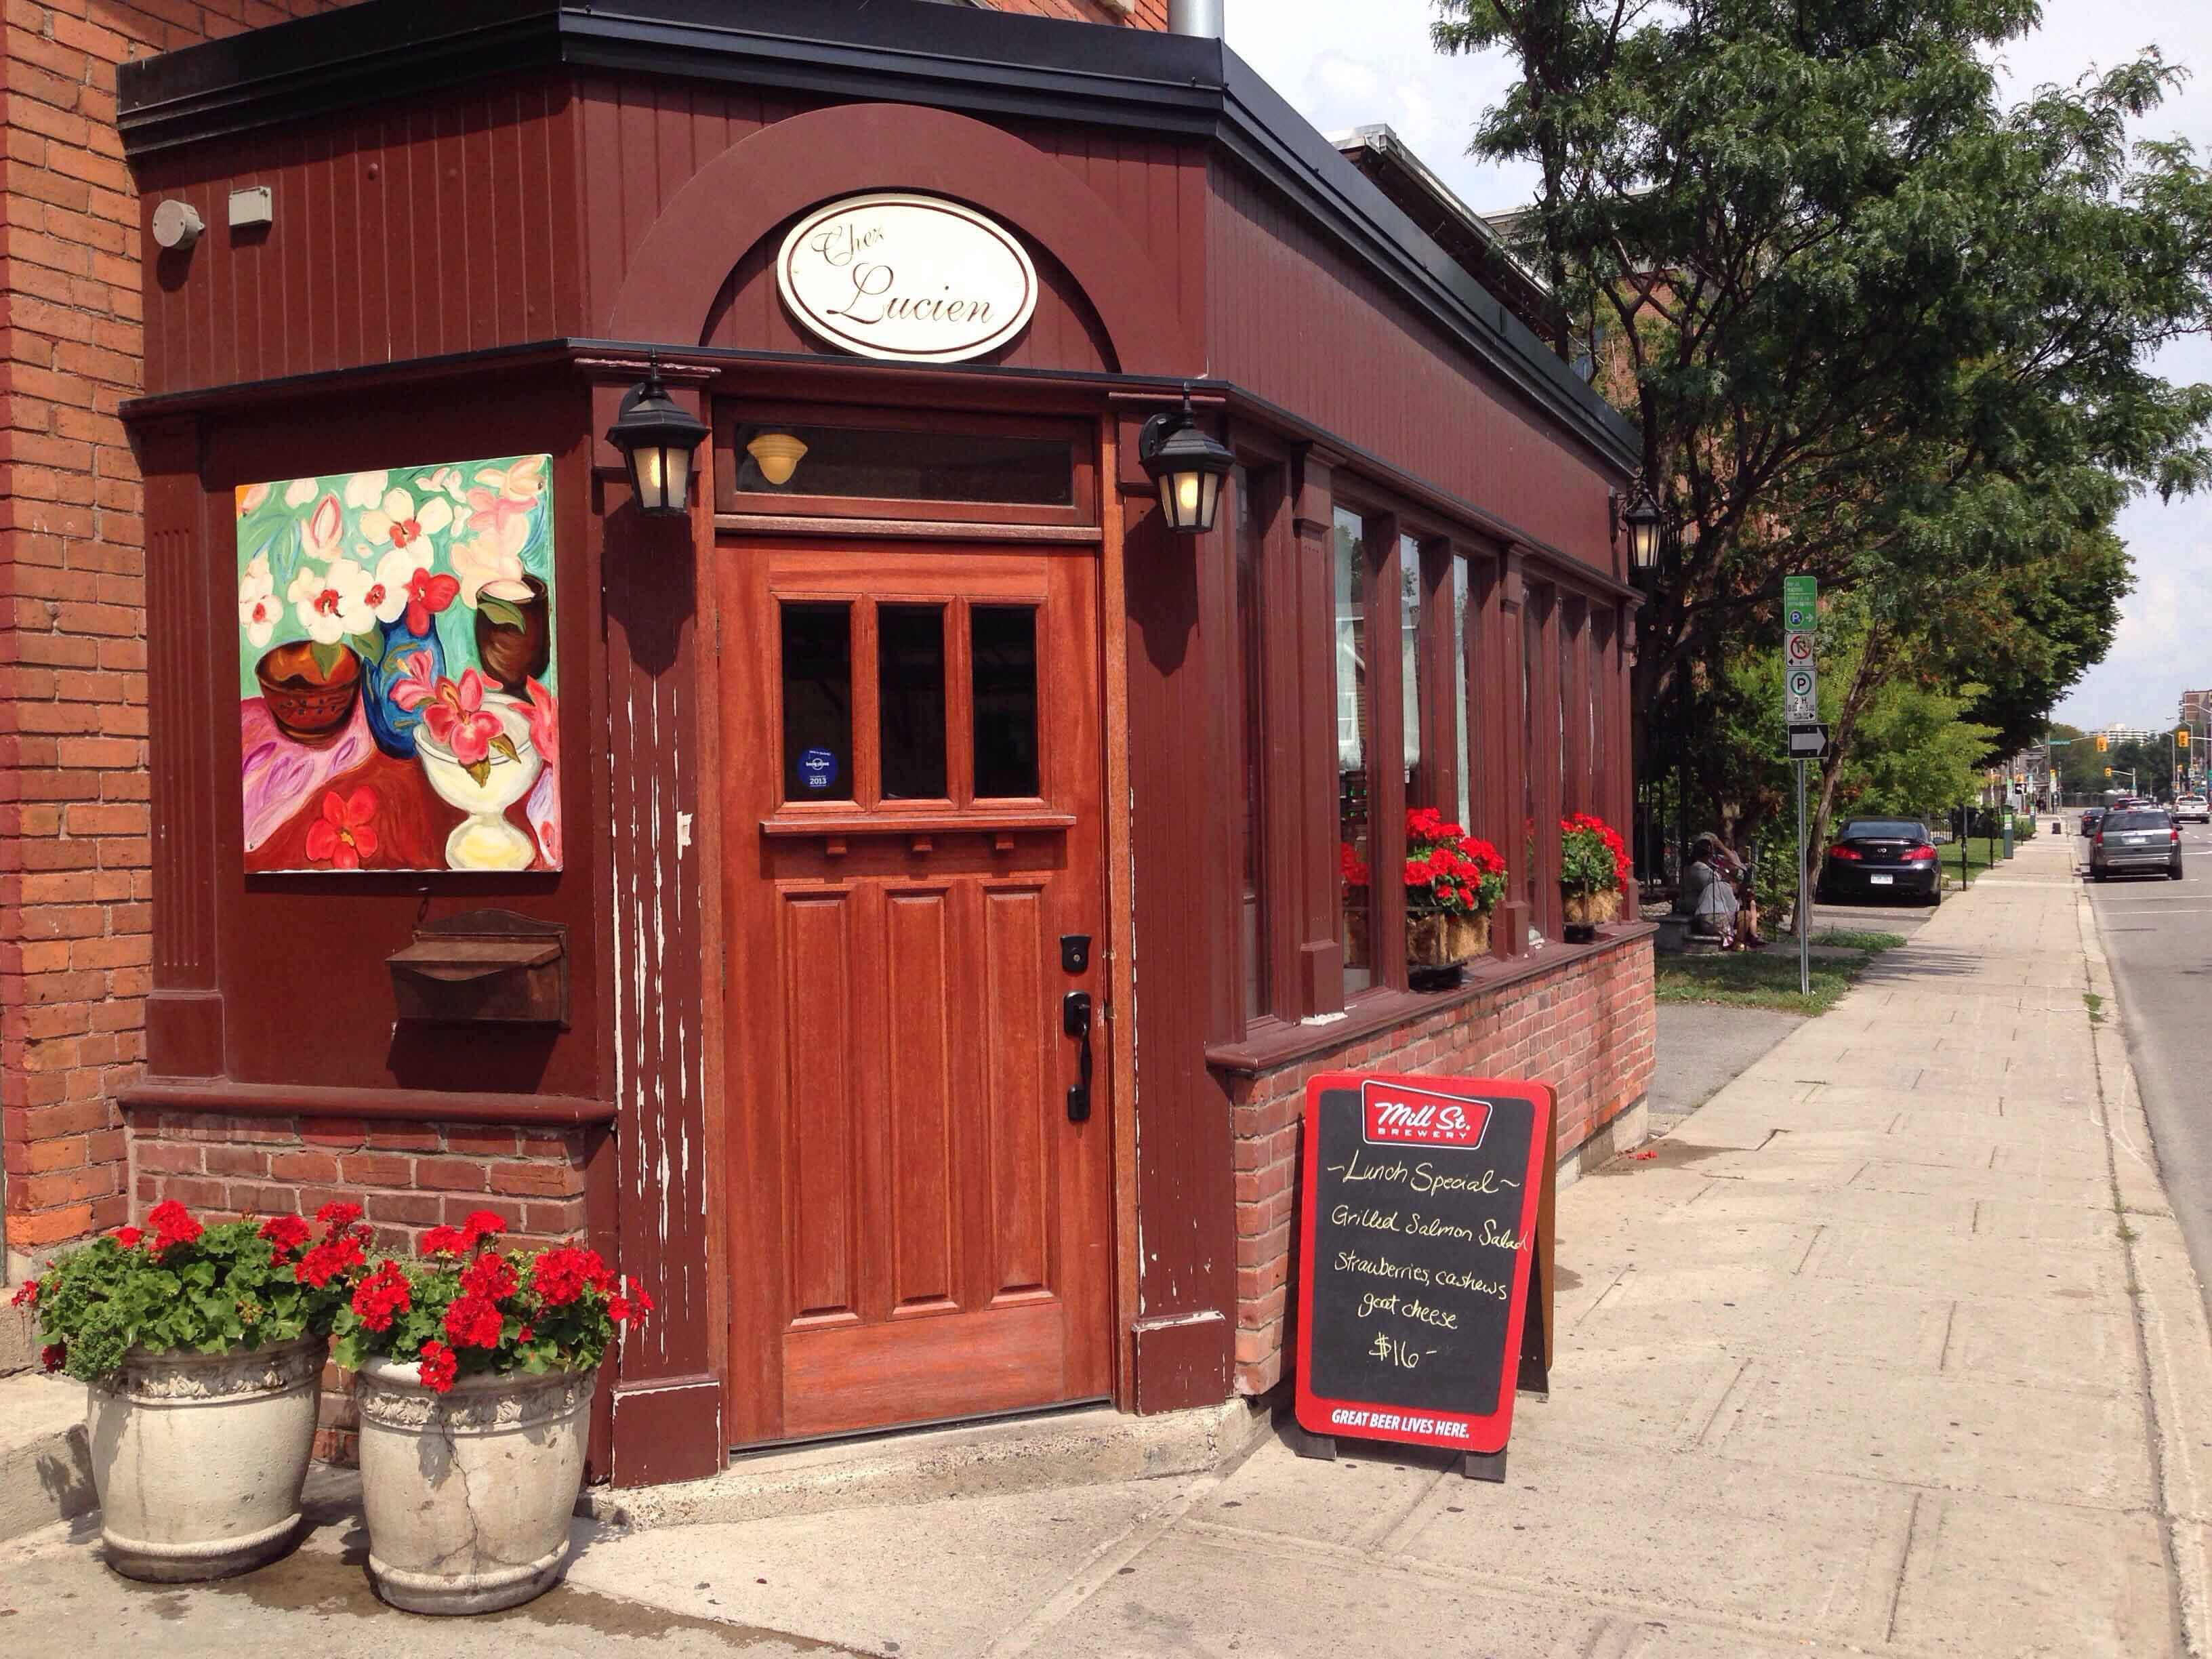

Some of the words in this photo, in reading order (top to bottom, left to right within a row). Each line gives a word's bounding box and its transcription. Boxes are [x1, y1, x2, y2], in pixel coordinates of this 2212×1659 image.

[810, 223, 885, 267] Chez
[826, 262, 994, 325] Lucien
[1797, 677, 1806, 691] P
[809, 777, 827, 785] 2013
[1374, 1102, 1436, 1127] Mill
[1435, 1105, 1471, 1131] St.
[1376, 1128, 1467, 1139] BREWERY
[1331, 1204, 1401, 1232] Grilled
[1405, 1212, 1473, 1242] Salmon
[1479, 1218, 1528, 1252] Salad
[1435, 1269, 1508, 1300] cashews
[1357, 1292, 1401, 1317] goat
[1401, 1300, 1458, 1330] cheese
[1331, 1408, 1371, 1427] GREAT
[1369, 1412, 1400, 1431] BEER
[1401, 1416, 1435, 1435] LIVES
[1435, 1420, 1470, 1439] HERE.
